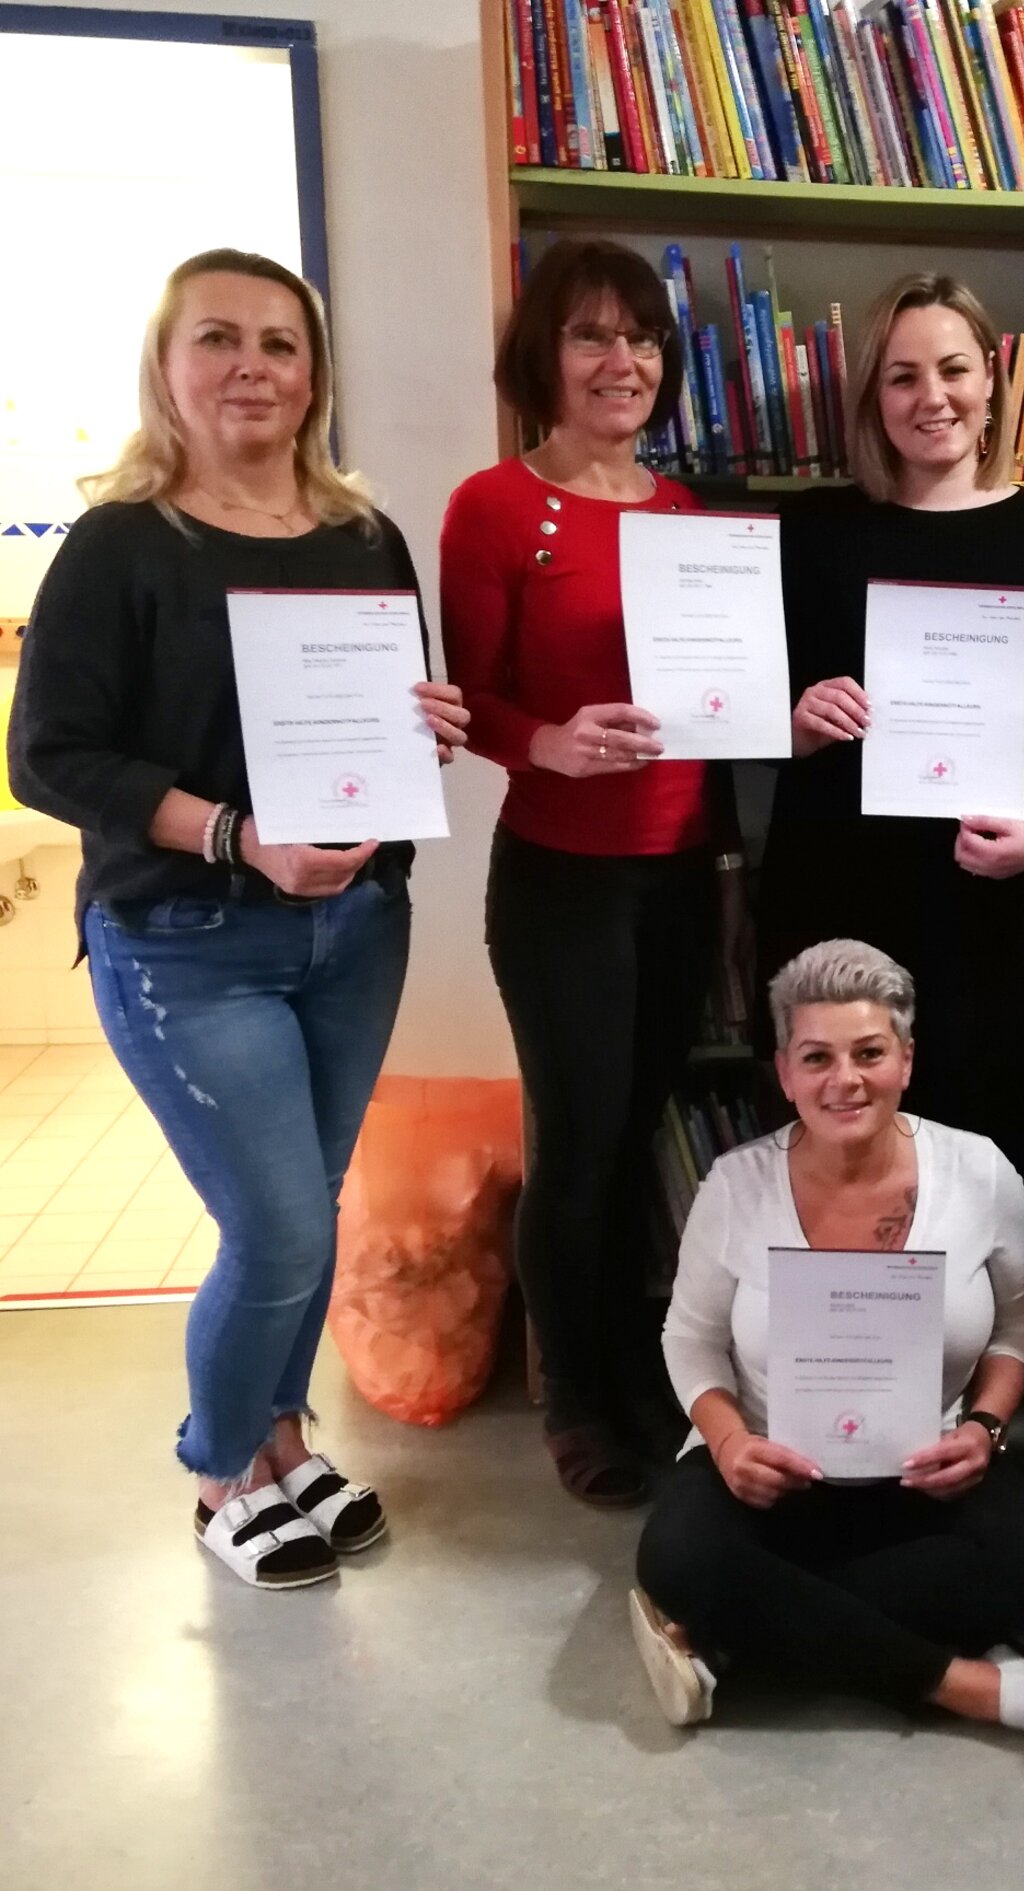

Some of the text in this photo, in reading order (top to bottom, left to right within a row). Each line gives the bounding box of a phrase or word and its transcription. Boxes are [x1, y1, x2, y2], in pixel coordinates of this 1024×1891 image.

[678, 563, 761, 575] BESCHEINIGUNG
[924, 632, 1009, 644] BESCHEINIGUNG
[301, 642, 399, 654] BESCHEINIGUNG
[830, 1290, 922, 1301] BESCHEINIGUNG
